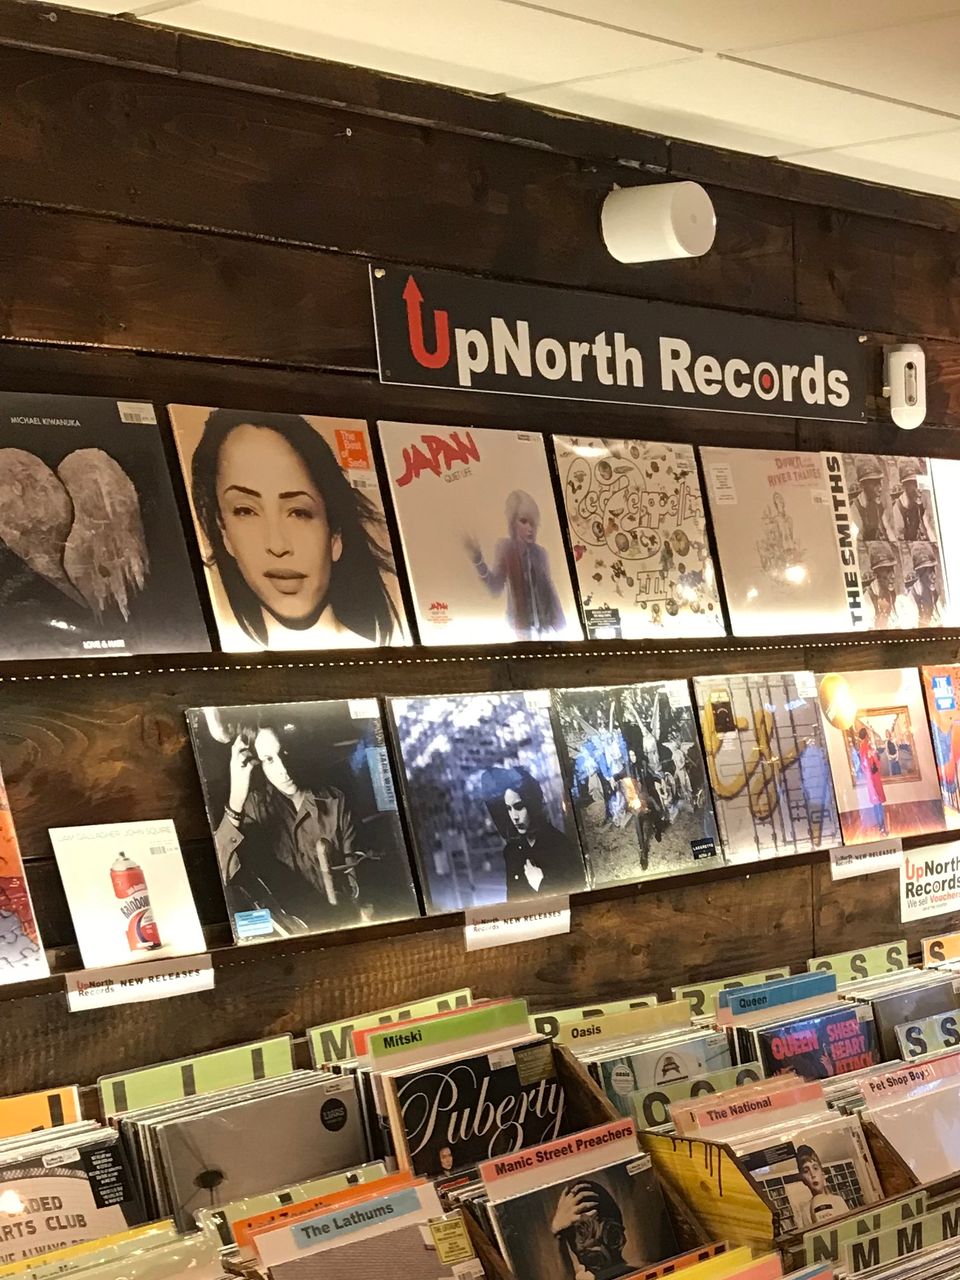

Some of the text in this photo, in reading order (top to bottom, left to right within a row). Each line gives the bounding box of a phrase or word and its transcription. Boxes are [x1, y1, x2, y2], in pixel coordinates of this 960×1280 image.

[403, 275, 850, 408] UpNorth Records
[10, 416, 81, 427] MICHAEL KIWANUKA
[396, 431, 480, 487] JAPAN
[826, 455, 863, 627] THE SMITHS
[907, 899, 918, 909] We
[918, 897, 928, 907] sell
[503, 910, 562, 925] NEW RELEASES
[76, 978, 114, 991] UpNorth
[120, 968, 201, 988] NEW RELEASES
[78, 986, 115, 997] Records
[738, 995, 768, 1009] Queen
[383, 1030, 424, 1049] Mitski
[570, 1024, 602, 1039] Oasis
[905, 1025, 928, 1058] S
[940, 1016, 960, 1047] S
[771, 1030, 819, 1060] QUEEN
[829, 1036, 865, 1060] HEART
[869, 1078, 886, 1093] Pet
[886, 1072, 908, 1091] Shop
[397, 1064, 566, 1158] Puberty
[707, 1096, 772, 1122] The National
[494, 1124, 634, 1177] Manic Street Preachers
[45, 1213, 88, 1232] CLUB
[301, 1202, 395, 1240] The Lathums
[851, 1237, 881, 1273] M
[897, 1221, 923, 1257] M
